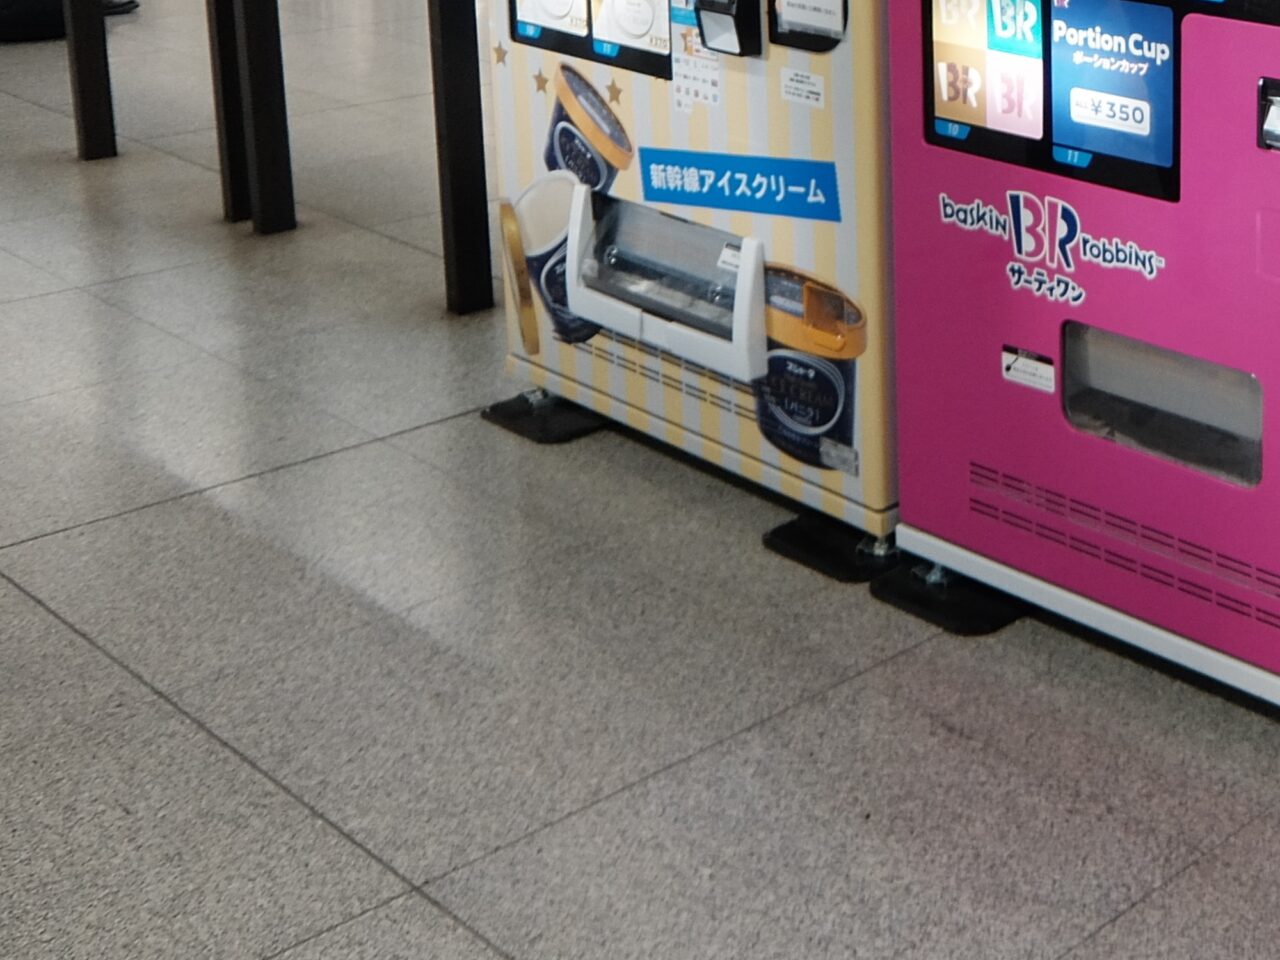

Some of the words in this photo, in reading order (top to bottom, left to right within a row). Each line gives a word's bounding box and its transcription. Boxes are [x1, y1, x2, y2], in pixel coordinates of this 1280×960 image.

[1052, 19, 1126, 54] Portion
[1128, 32, 1170, 66] Cup
[1072, 50, 1149, 76] ポーションカップ
[937, 61, 982, 108] BR
[947, 122, 960, 136] 10
[1090, 97, 1145, 125] ¥350
[1067, 150, 1079, 163] 11
[649, 163, 826, 204] 新幹線アイスクリーム
[1006, 190, 1080, 270] BR
[1007, 262, 1085, 304] サーティワン
